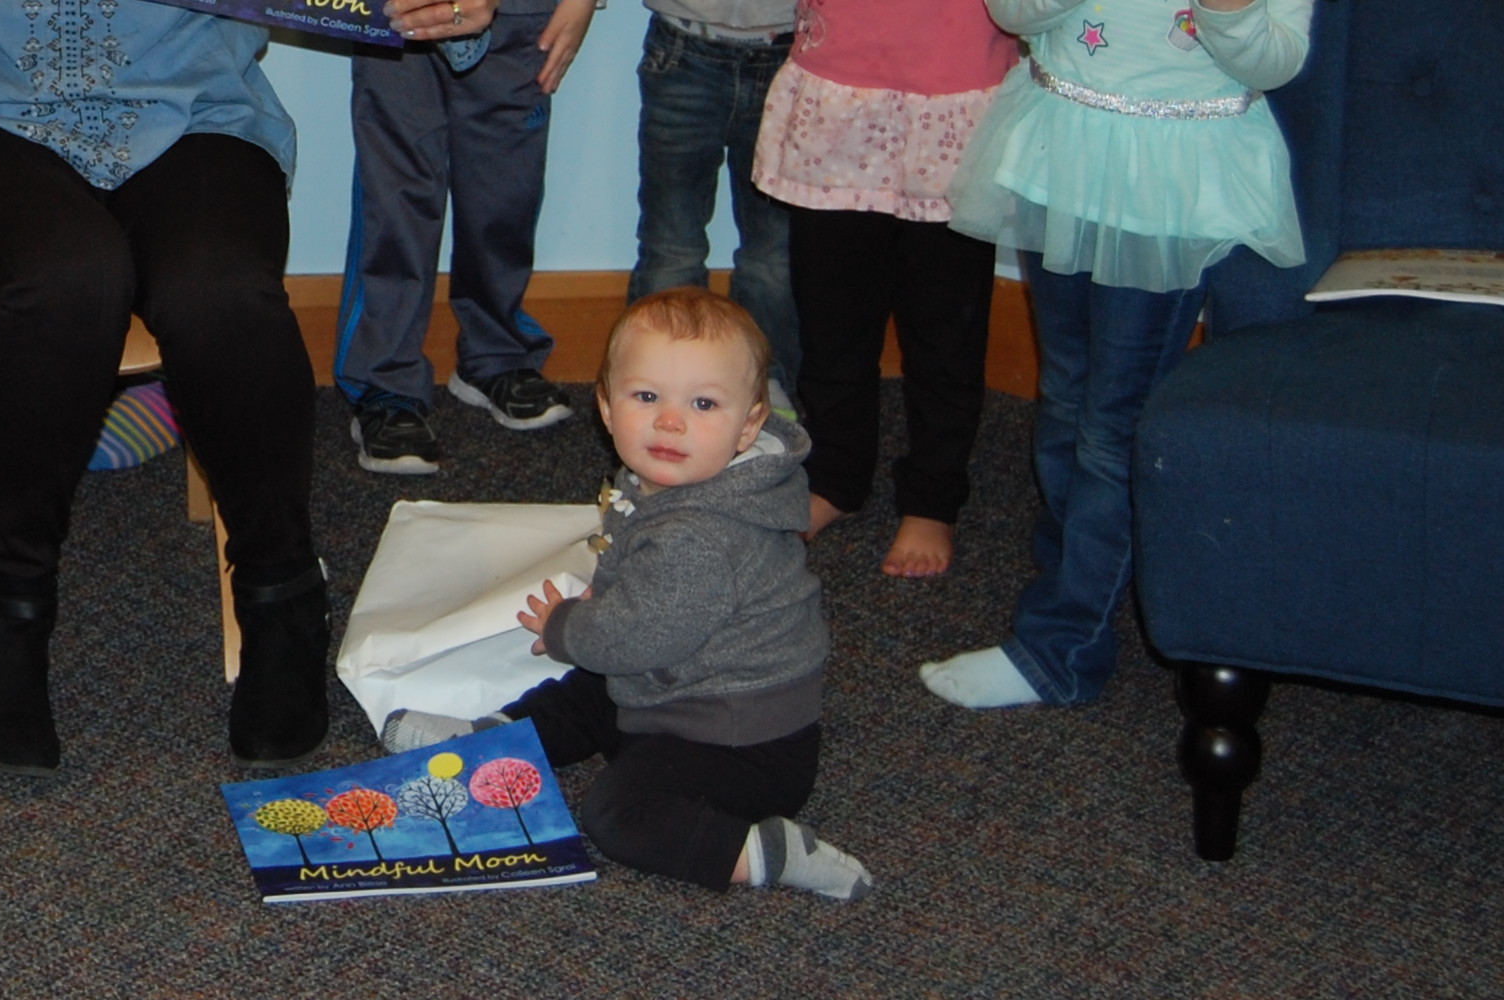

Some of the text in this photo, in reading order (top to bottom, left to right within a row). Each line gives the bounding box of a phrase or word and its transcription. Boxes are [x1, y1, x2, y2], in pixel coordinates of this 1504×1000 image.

[265, 7, 390, 38] illustrated by Colleen Sgroi
[299, 852, 547, 881] Mindful Moon
[501, 867, 546, 880] Colleen
[332, 880, 356, 890] Ann
